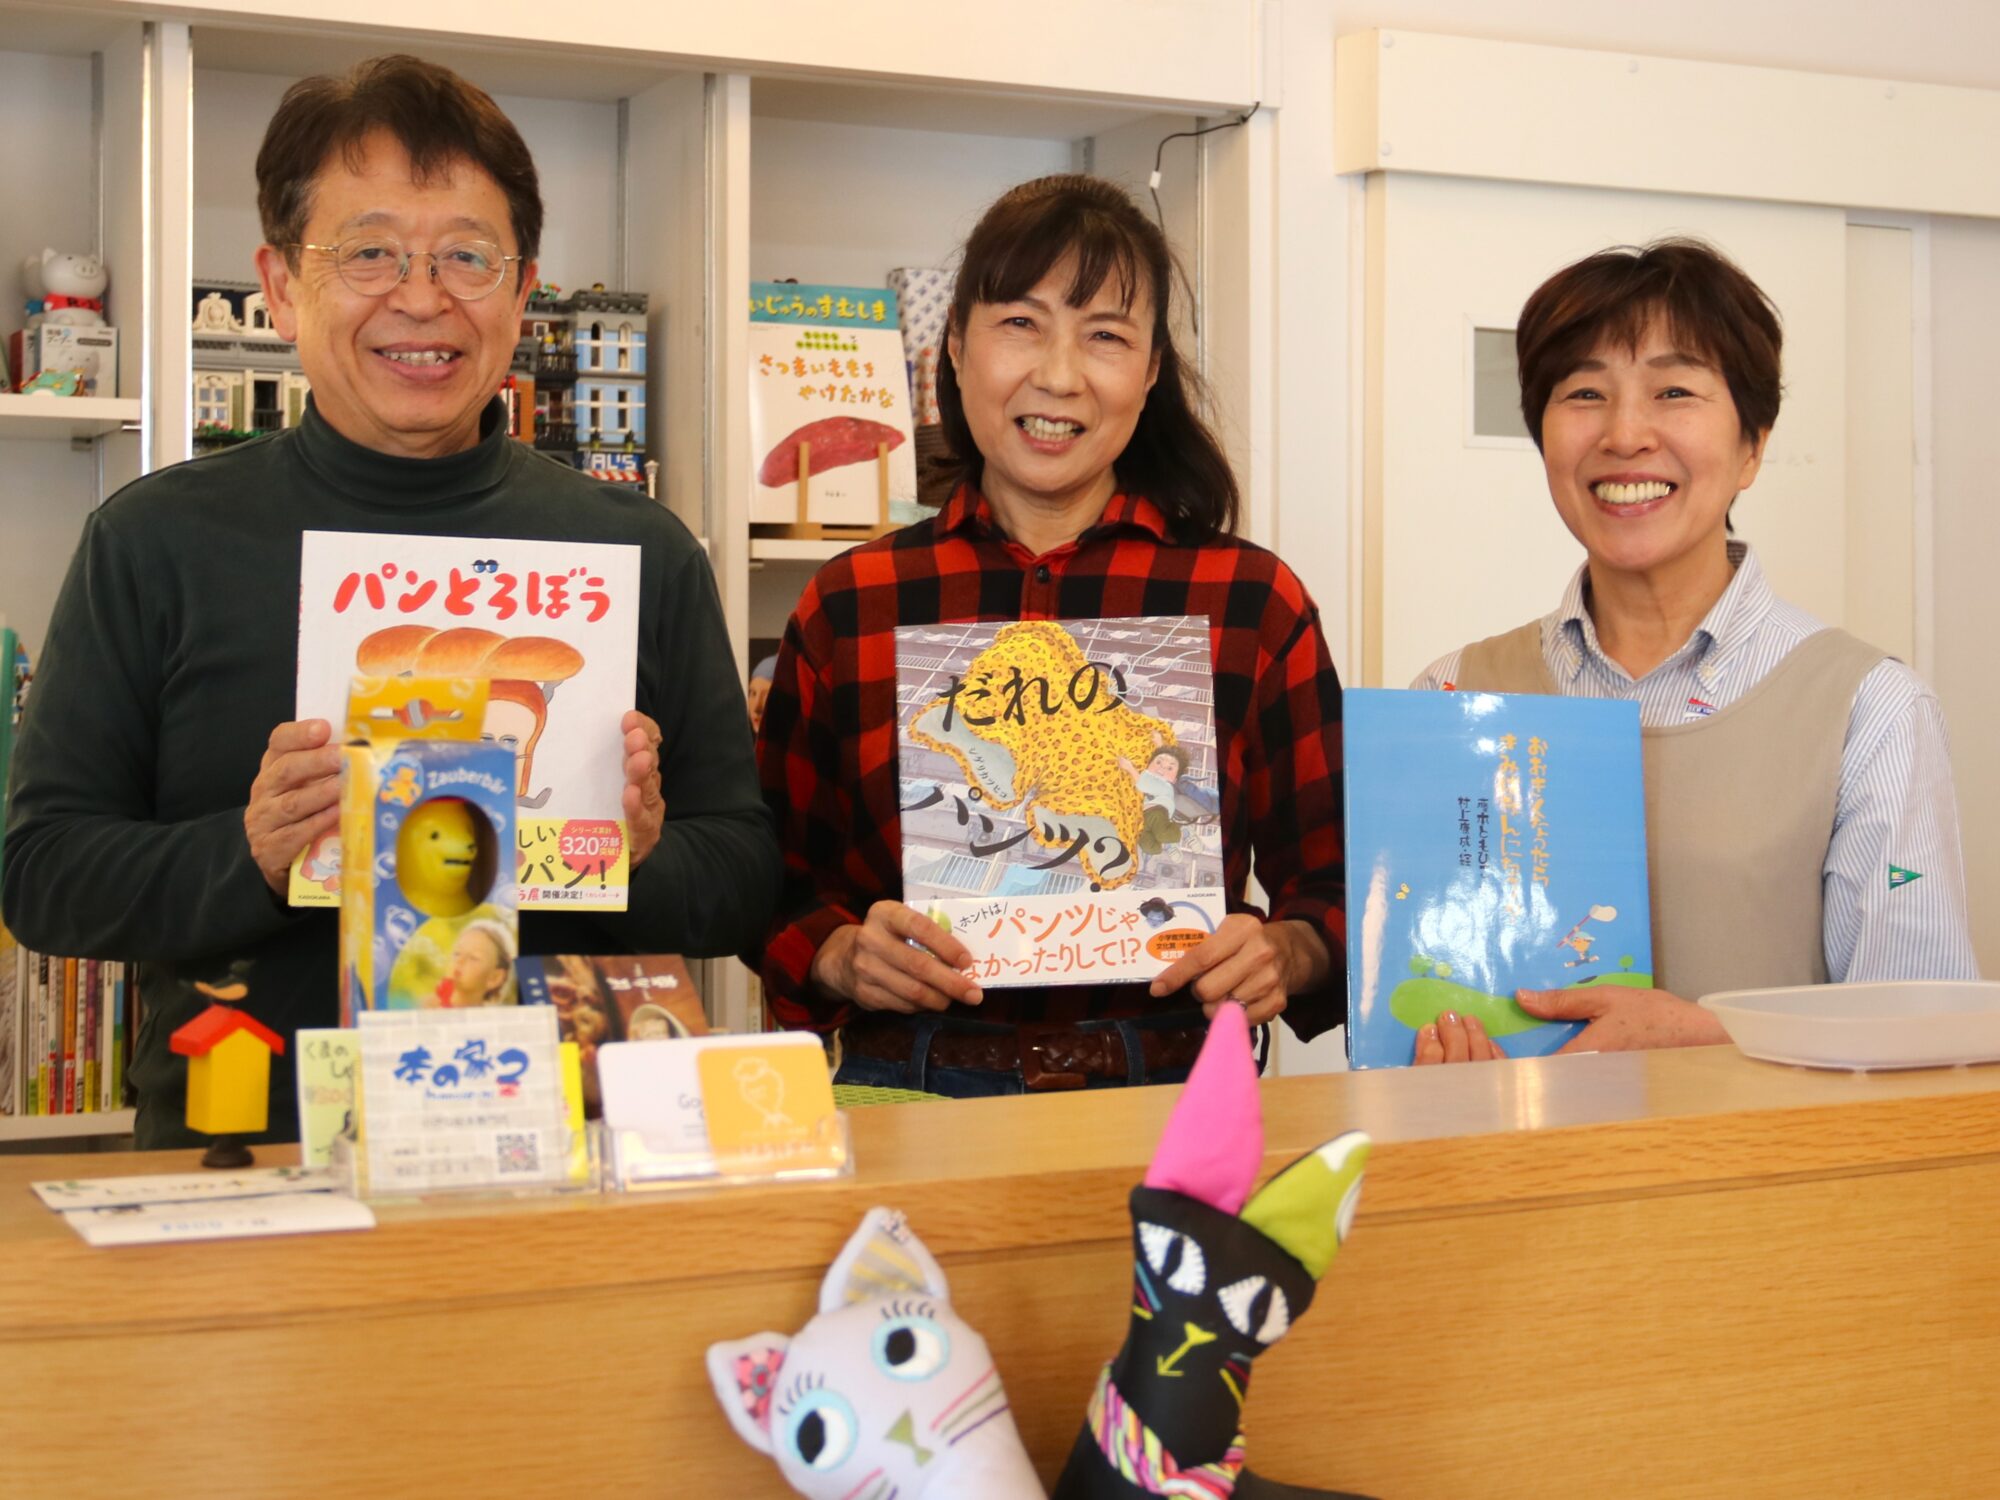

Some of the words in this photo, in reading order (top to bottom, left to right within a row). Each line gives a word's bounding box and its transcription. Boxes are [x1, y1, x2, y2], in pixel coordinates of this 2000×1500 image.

[798, 384, 895, 408] やけたかな
[333, 562, 610, 623] パンどろぼう
[937, 661, 1128, 732] だれの
[562, 836, 600, 856] 320
[520, 855, 606, 890] パン!
[959, 903, 1002, 928] ホントは
[988, 903, 1140, 943] パンツじゃ
